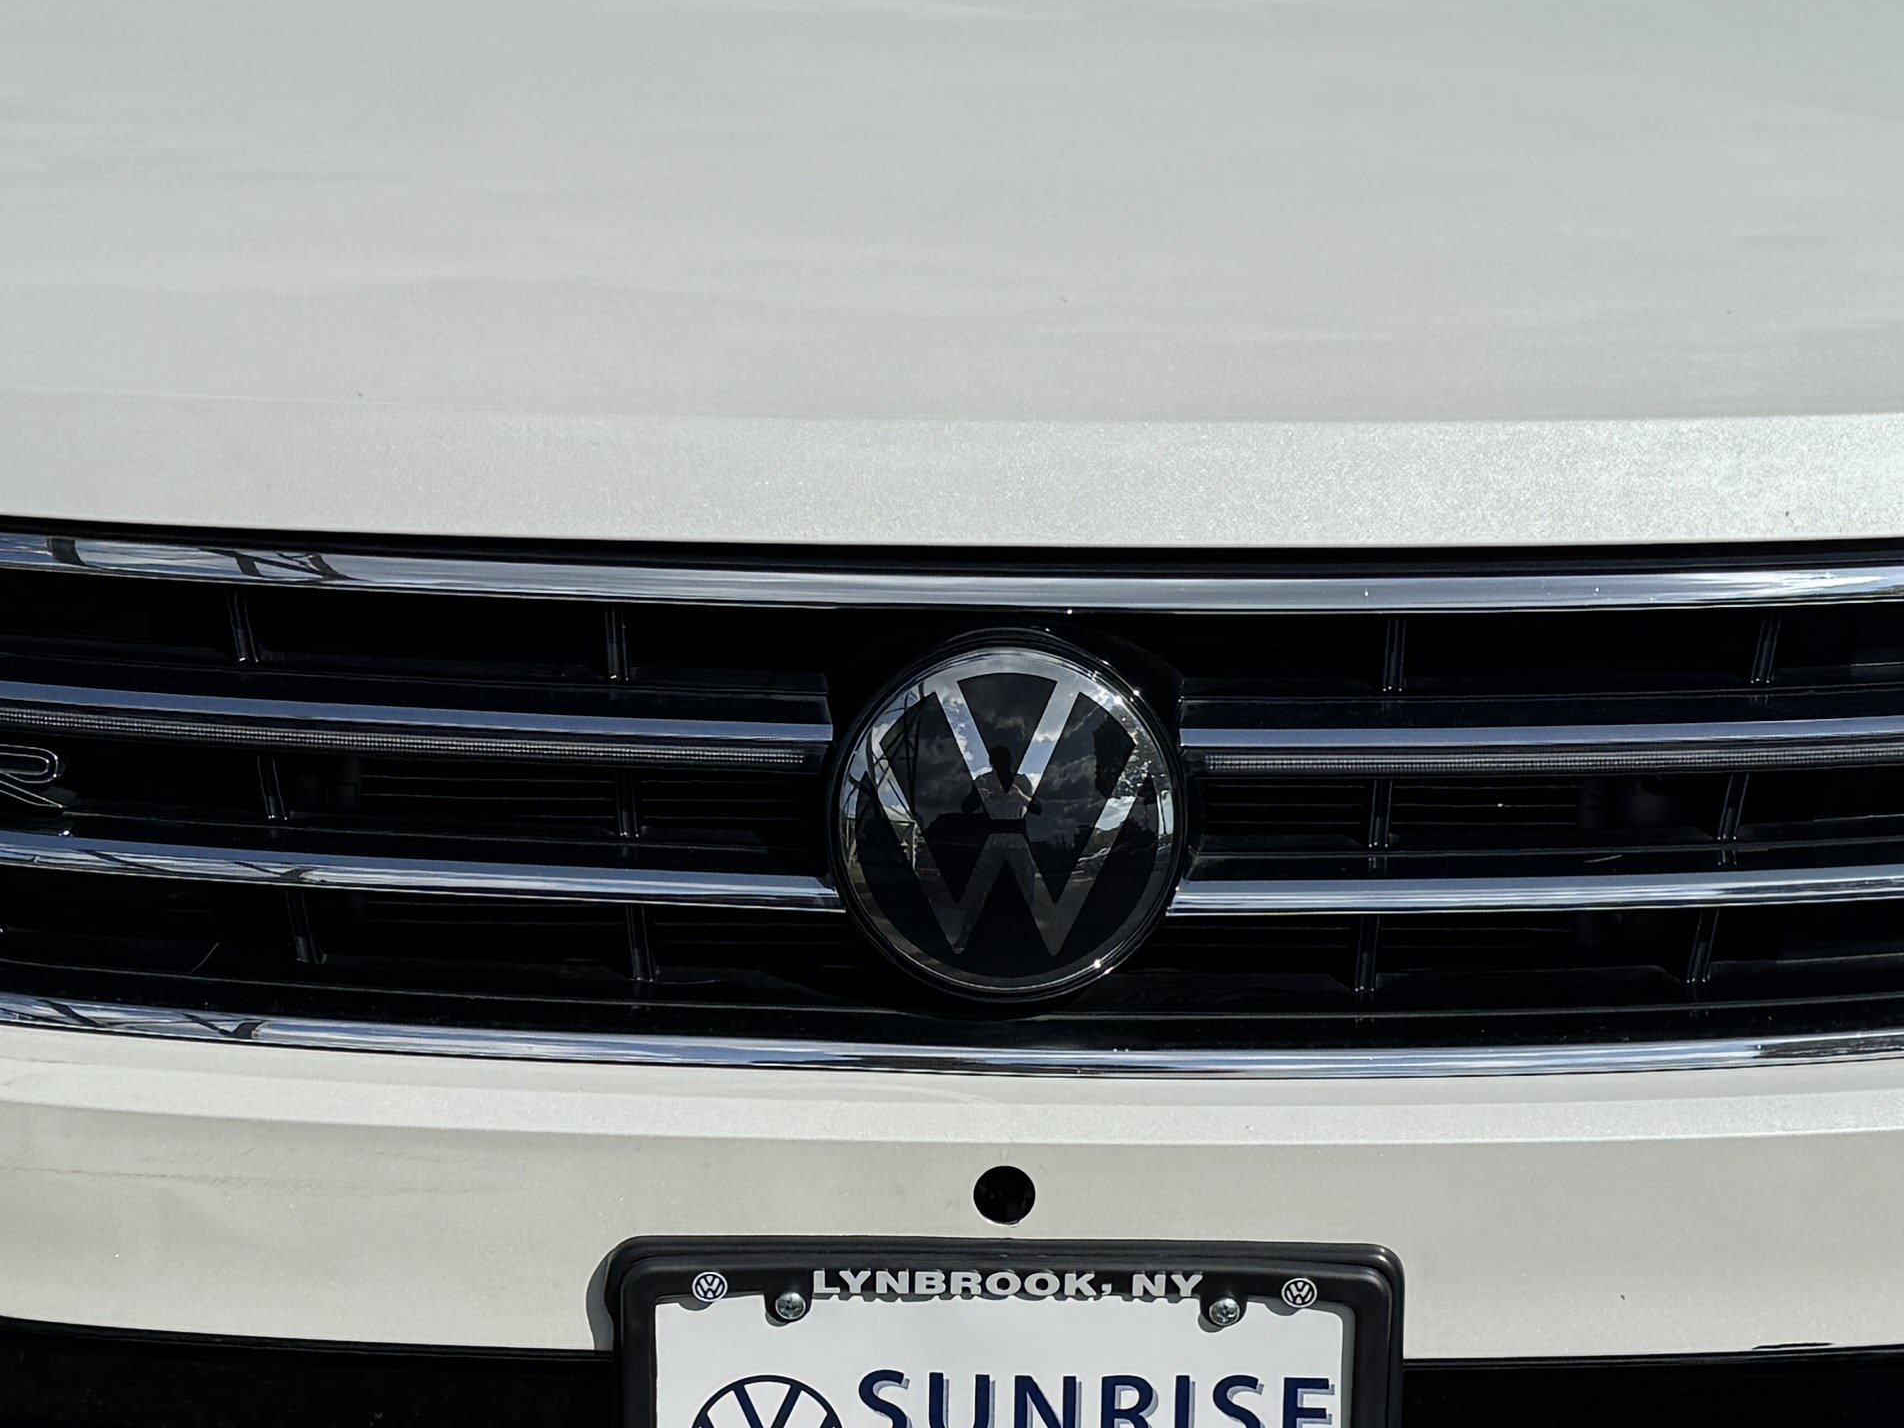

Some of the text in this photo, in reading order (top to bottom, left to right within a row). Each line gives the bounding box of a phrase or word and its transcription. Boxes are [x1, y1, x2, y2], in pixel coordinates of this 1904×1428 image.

[851, 654, 1164, 966] VW
[812, 1270, 1203, 1298] LYNBROOK, NY
